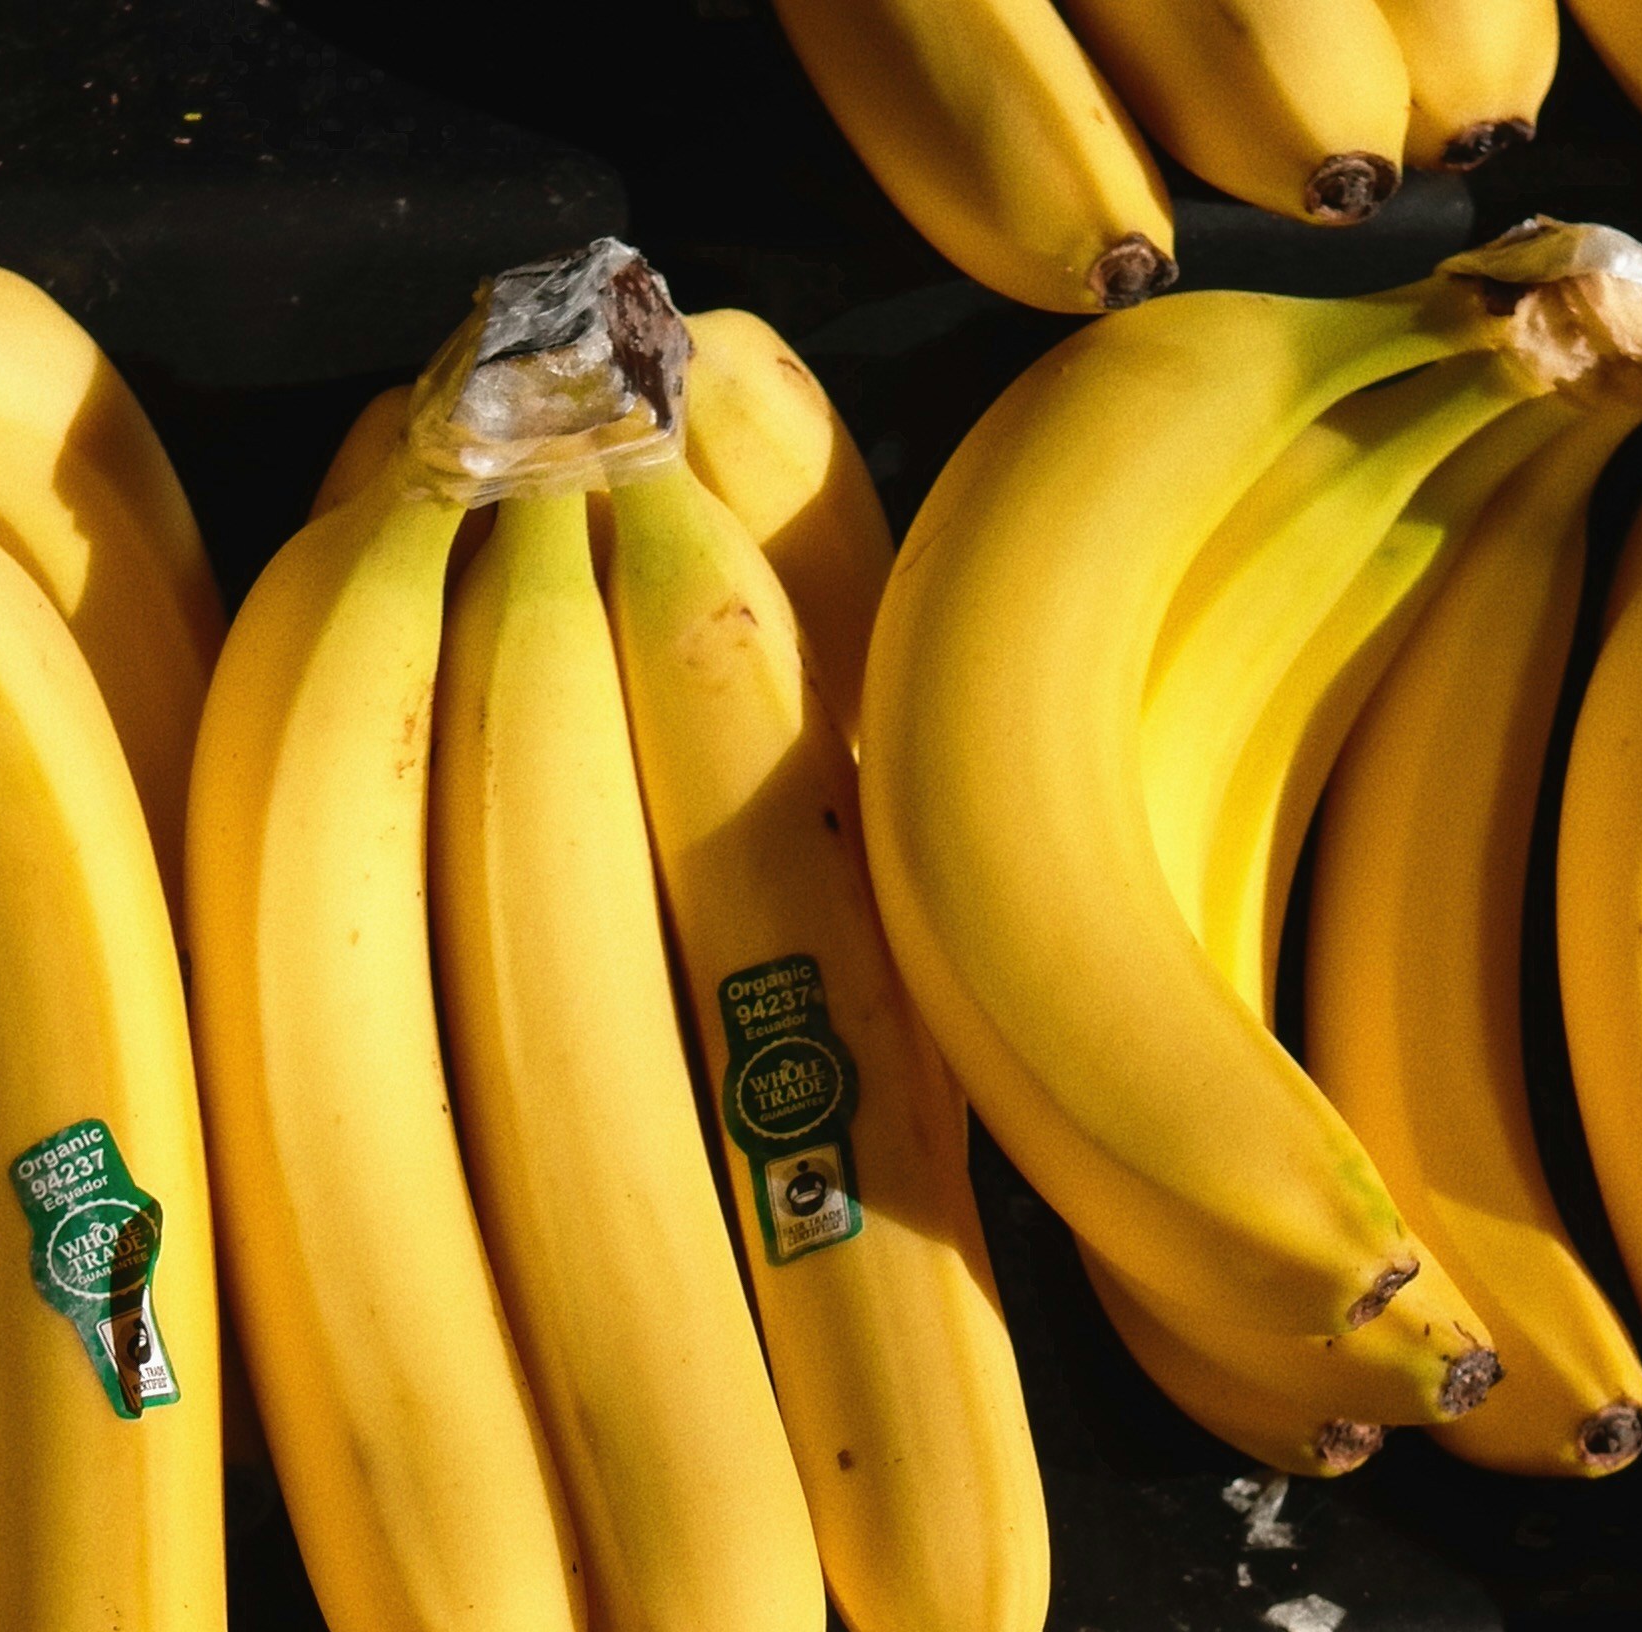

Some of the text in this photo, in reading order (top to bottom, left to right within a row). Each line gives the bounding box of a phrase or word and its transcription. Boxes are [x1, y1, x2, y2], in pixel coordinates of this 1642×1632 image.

[727, 963, 812, 1000] Organic
[736, 986, 808, 1026] 94237
[745, 1013, 807, 1040] Ecuador
[748, 1059, 826, 1094] WHOLE
[755, 1074, 828, 1110] TRADE
[760, 1096, 826, 1122] GUARANTEE
[17, 1126, 104, 1179] Organic
[30, 1148, 105, 1201] 94237
[43, 1175, 108, 1212] Ecuador
[808, 1208, 845, 1230] TRADE
[57, 1217, 140, 1259] WHOLE
[68, 1232, 147, 1276] TRADE
[78, 1253, 150, 1285] GUARANTEE
